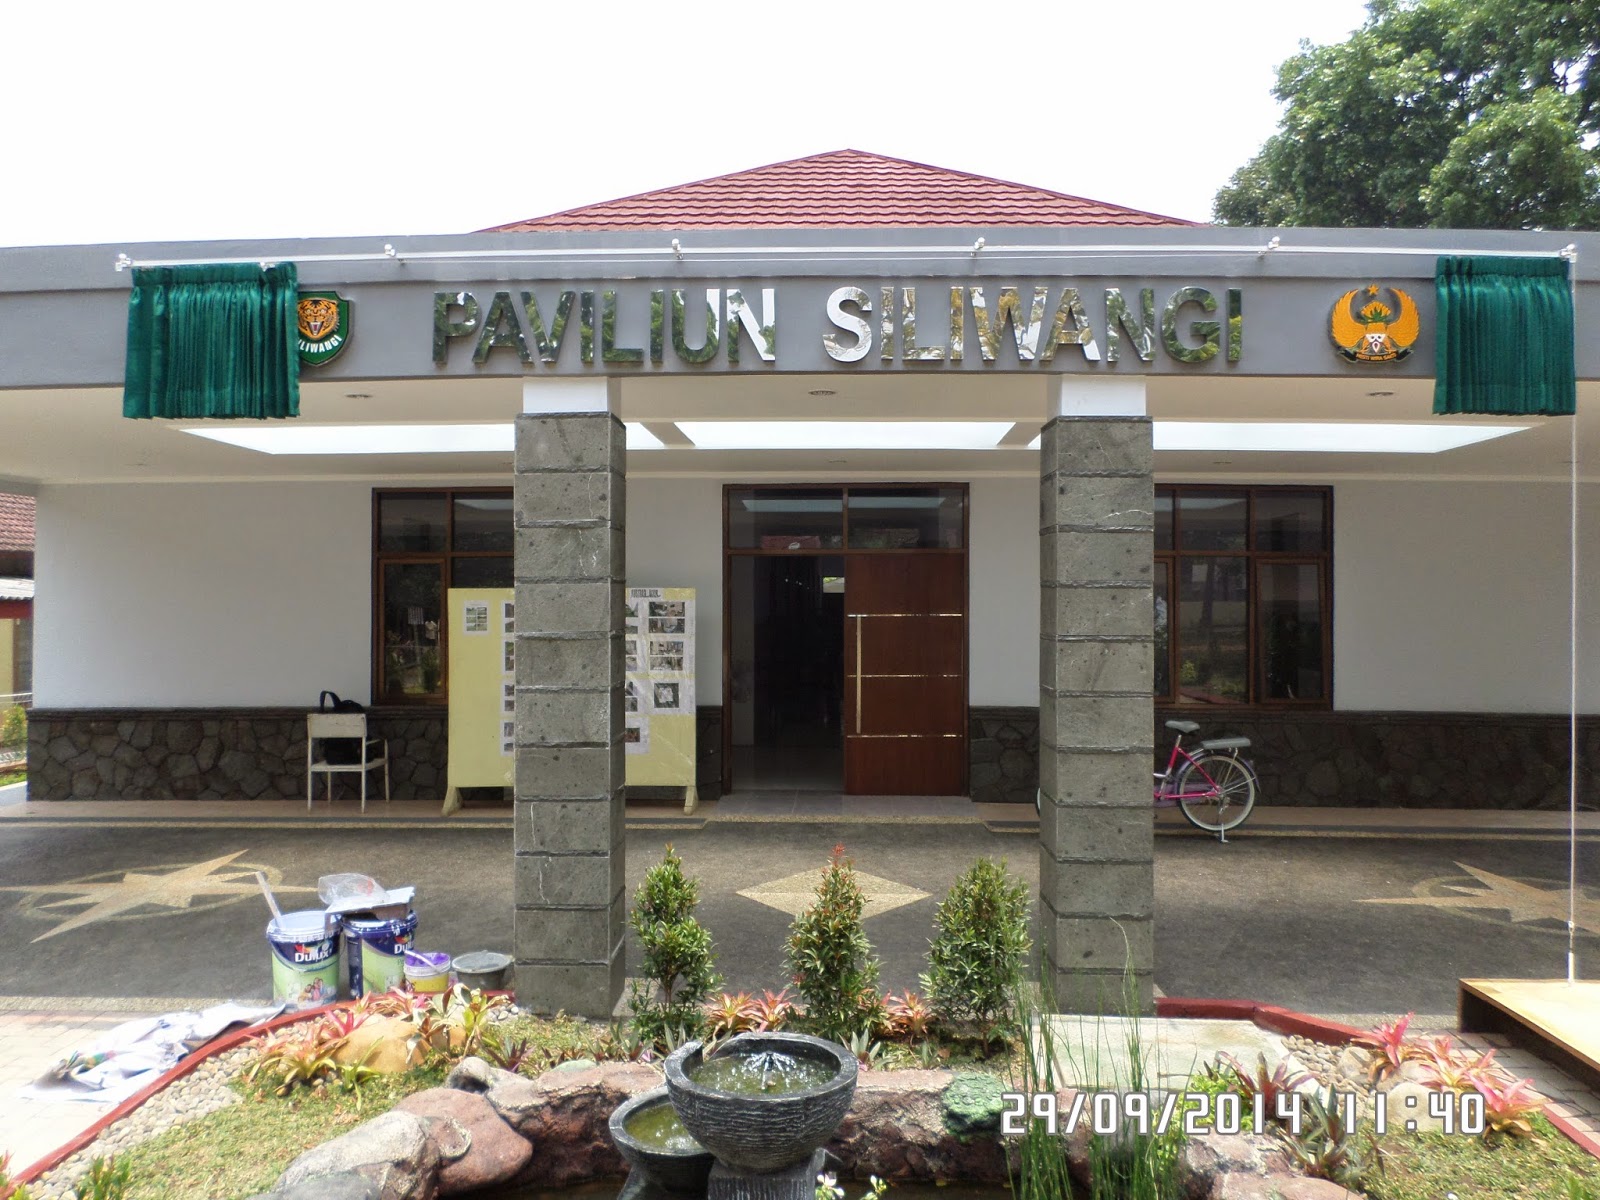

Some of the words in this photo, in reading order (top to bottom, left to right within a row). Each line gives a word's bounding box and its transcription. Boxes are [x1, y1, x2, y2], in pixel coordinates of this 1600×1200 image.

[298, 334, 343, 353] ILIWANGI
[432, 289, 776, 365] PAVILIUN
[822, 286, 1243, 363] SILIWANGI
